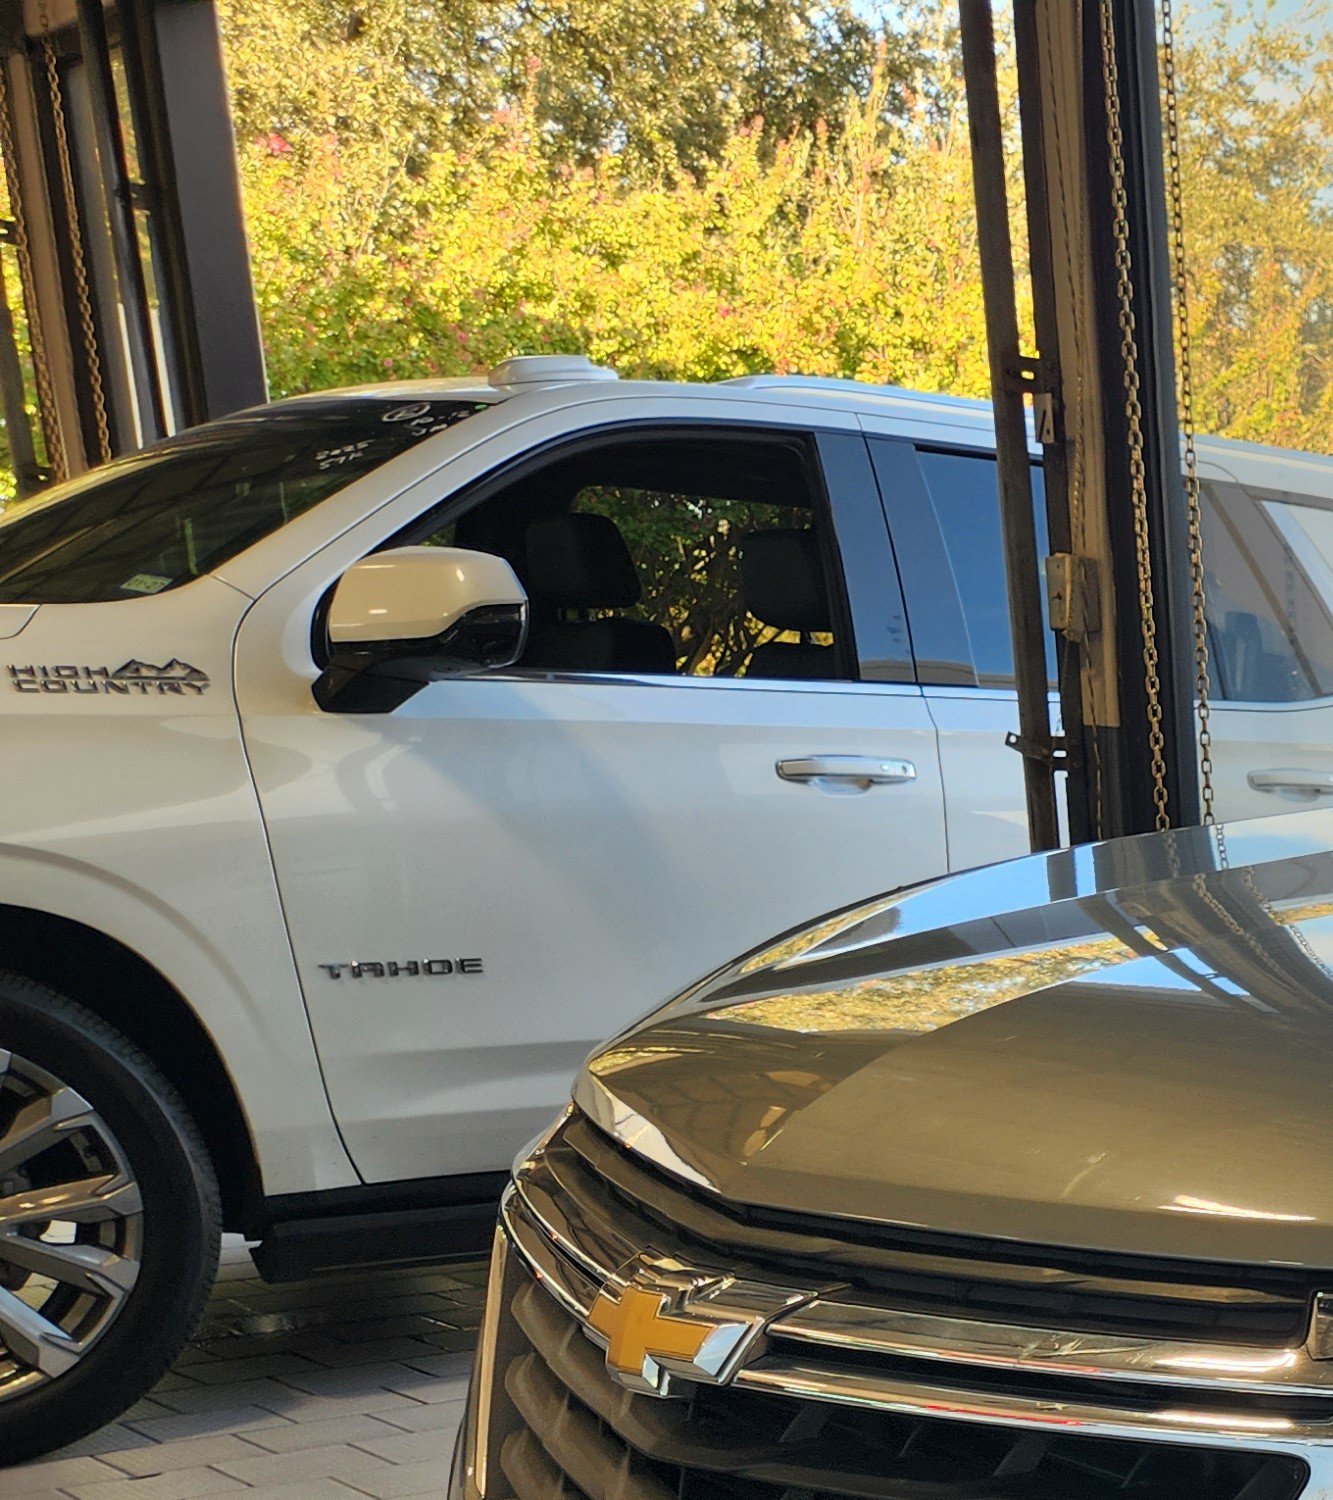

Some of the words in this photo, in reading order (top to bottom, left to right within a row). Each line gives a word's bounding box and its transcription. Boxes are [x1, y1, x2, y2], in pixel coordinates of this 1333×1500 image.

[8, 663, 110, 679] HIGH
[13, 679, 210, 696] COUNTRY
[317, 957, 484, 980] TAHOE
